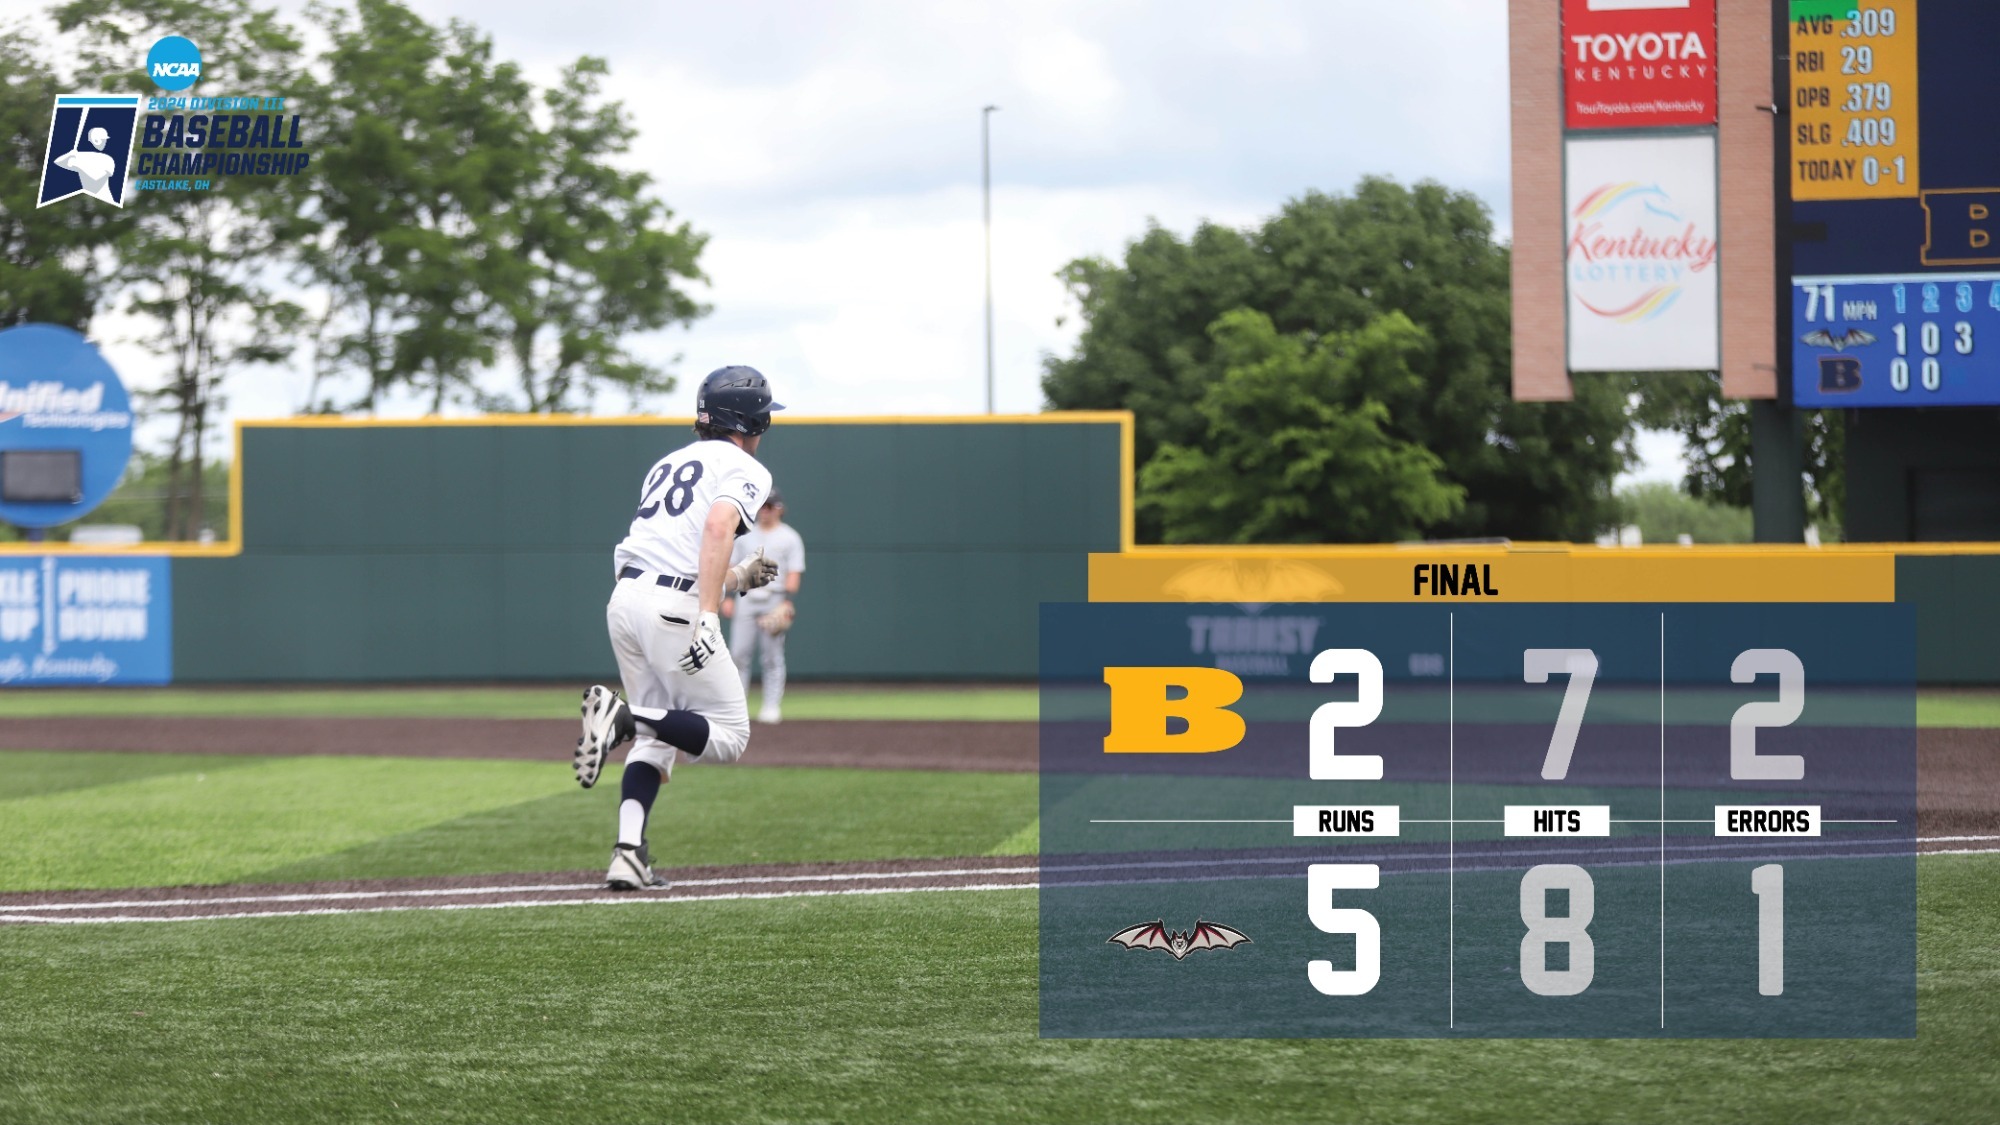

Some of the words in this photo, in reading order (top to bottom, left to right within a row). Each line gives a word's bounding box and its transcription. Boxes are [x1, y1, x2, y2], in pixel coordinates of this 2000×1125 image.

[1797, 14, 1833, 36] AVG
[1841, 8, 1896, 38] .309
[1571, 31, 1708, 62] TOYOTA
[1797, 51, 1824, 73] RBI
[1841, 45, 1874, 75] 29
[1574, 64, 1708, 82] KENTUCKY
[1841, 81, 1892, 112] .379
[1797, 123, 1832, 146] SLG
[1841, 116, 1896, 147] .409
[1798, 159, 1857, 182] TODAY
[1567, 221, 1718, 274] Kentucky
[1573, 262, 1683, 282] LOTTERY
[1802, 283, 1836, 323] 71
[1842, 300, 1878, 322] MPH
[1892, 282, 1906, 314] 1
[1922, 282, 1940, 313] 2
[1955, 281, 1973, 313] 3
[1892, 322, 1907, 356] 1
[1921, 321, 1941, 355] 0
[1954, 320, 1973, 355] 3
[1890, 357, 1910, 392] 0
[1921, 357, 1941, 391] 0
[633, 460, 704, 521] 28
[58, 568, 151, 606] PHONE
[0, 606, 39, 643] UP
[58, 606, 149, 642] DOWN
